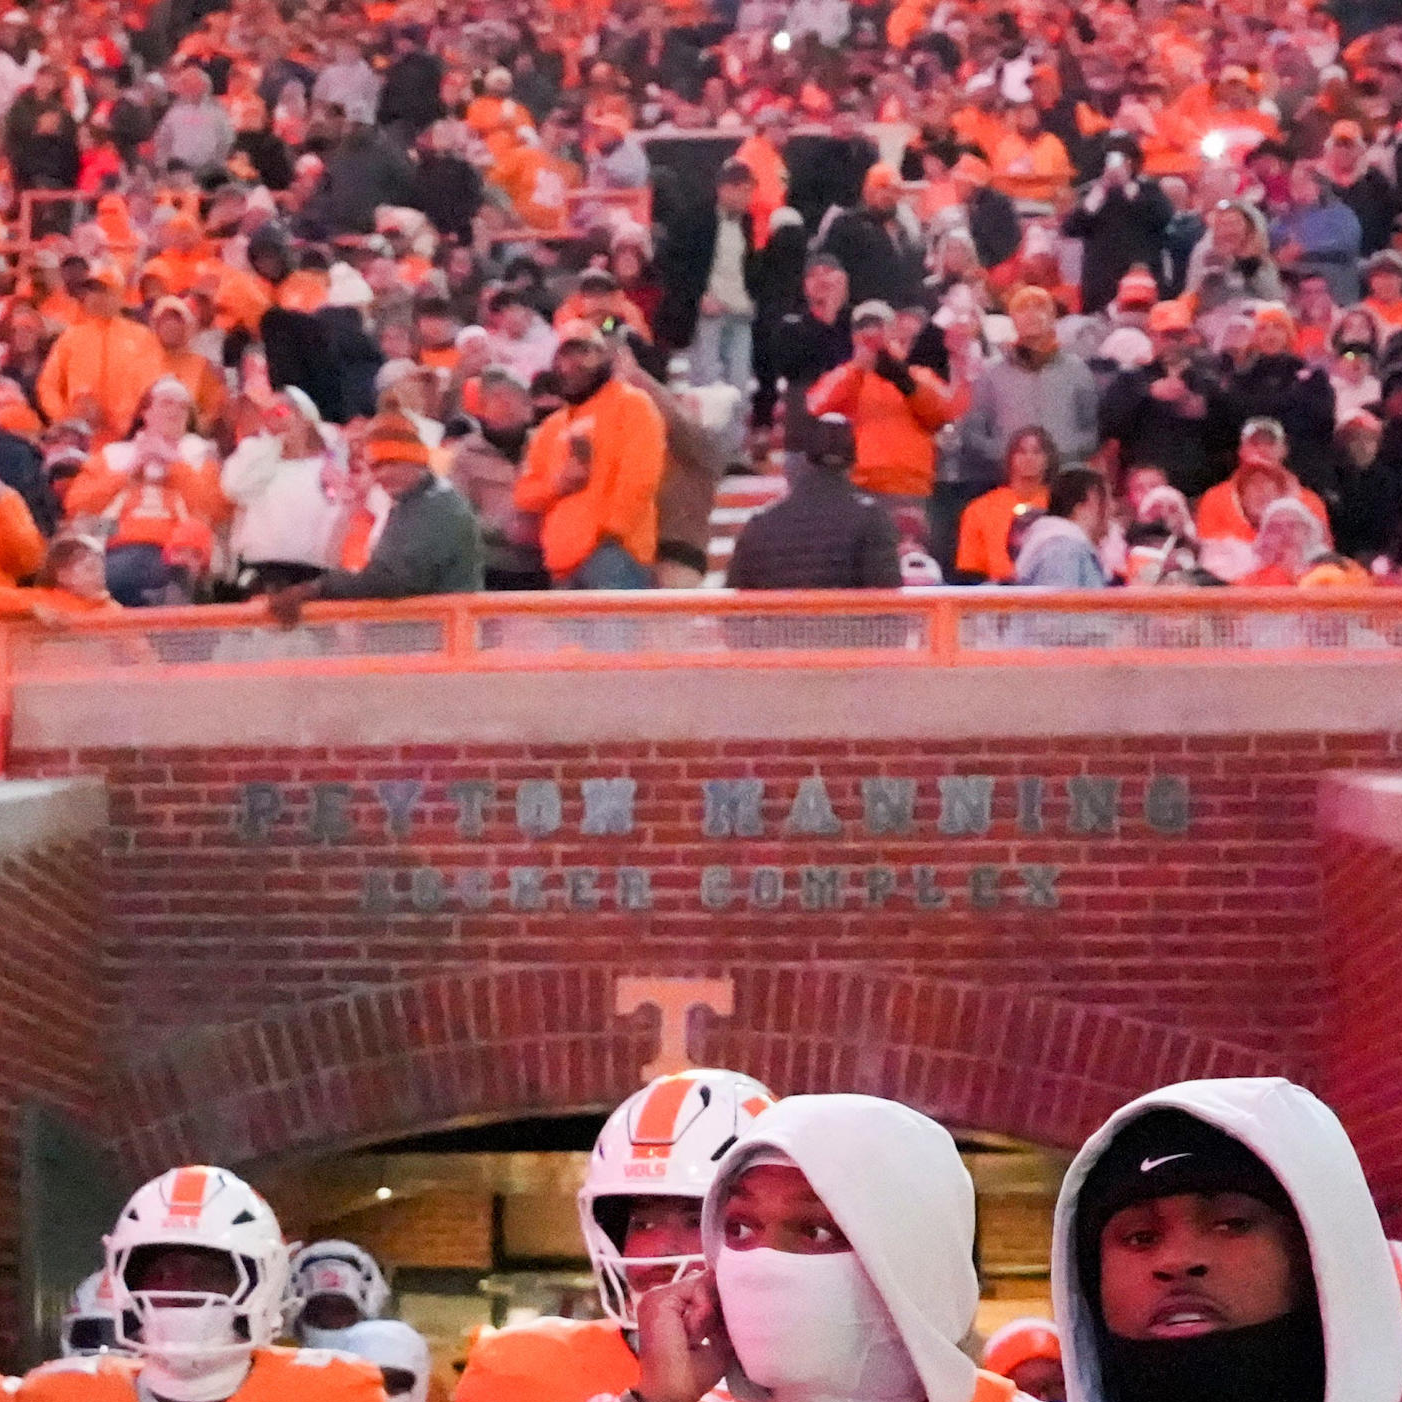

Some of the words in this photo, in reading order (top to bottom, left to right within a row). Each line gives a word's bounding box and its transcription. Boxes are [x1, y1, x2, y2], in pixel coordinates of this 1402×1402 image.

[237, 777, 638, 841] PEYTON
[701, 774, 1190, 838] MANNING
[700, 864, 1063, 910] COMPLEX
[616, 975, 734, 1082] T
